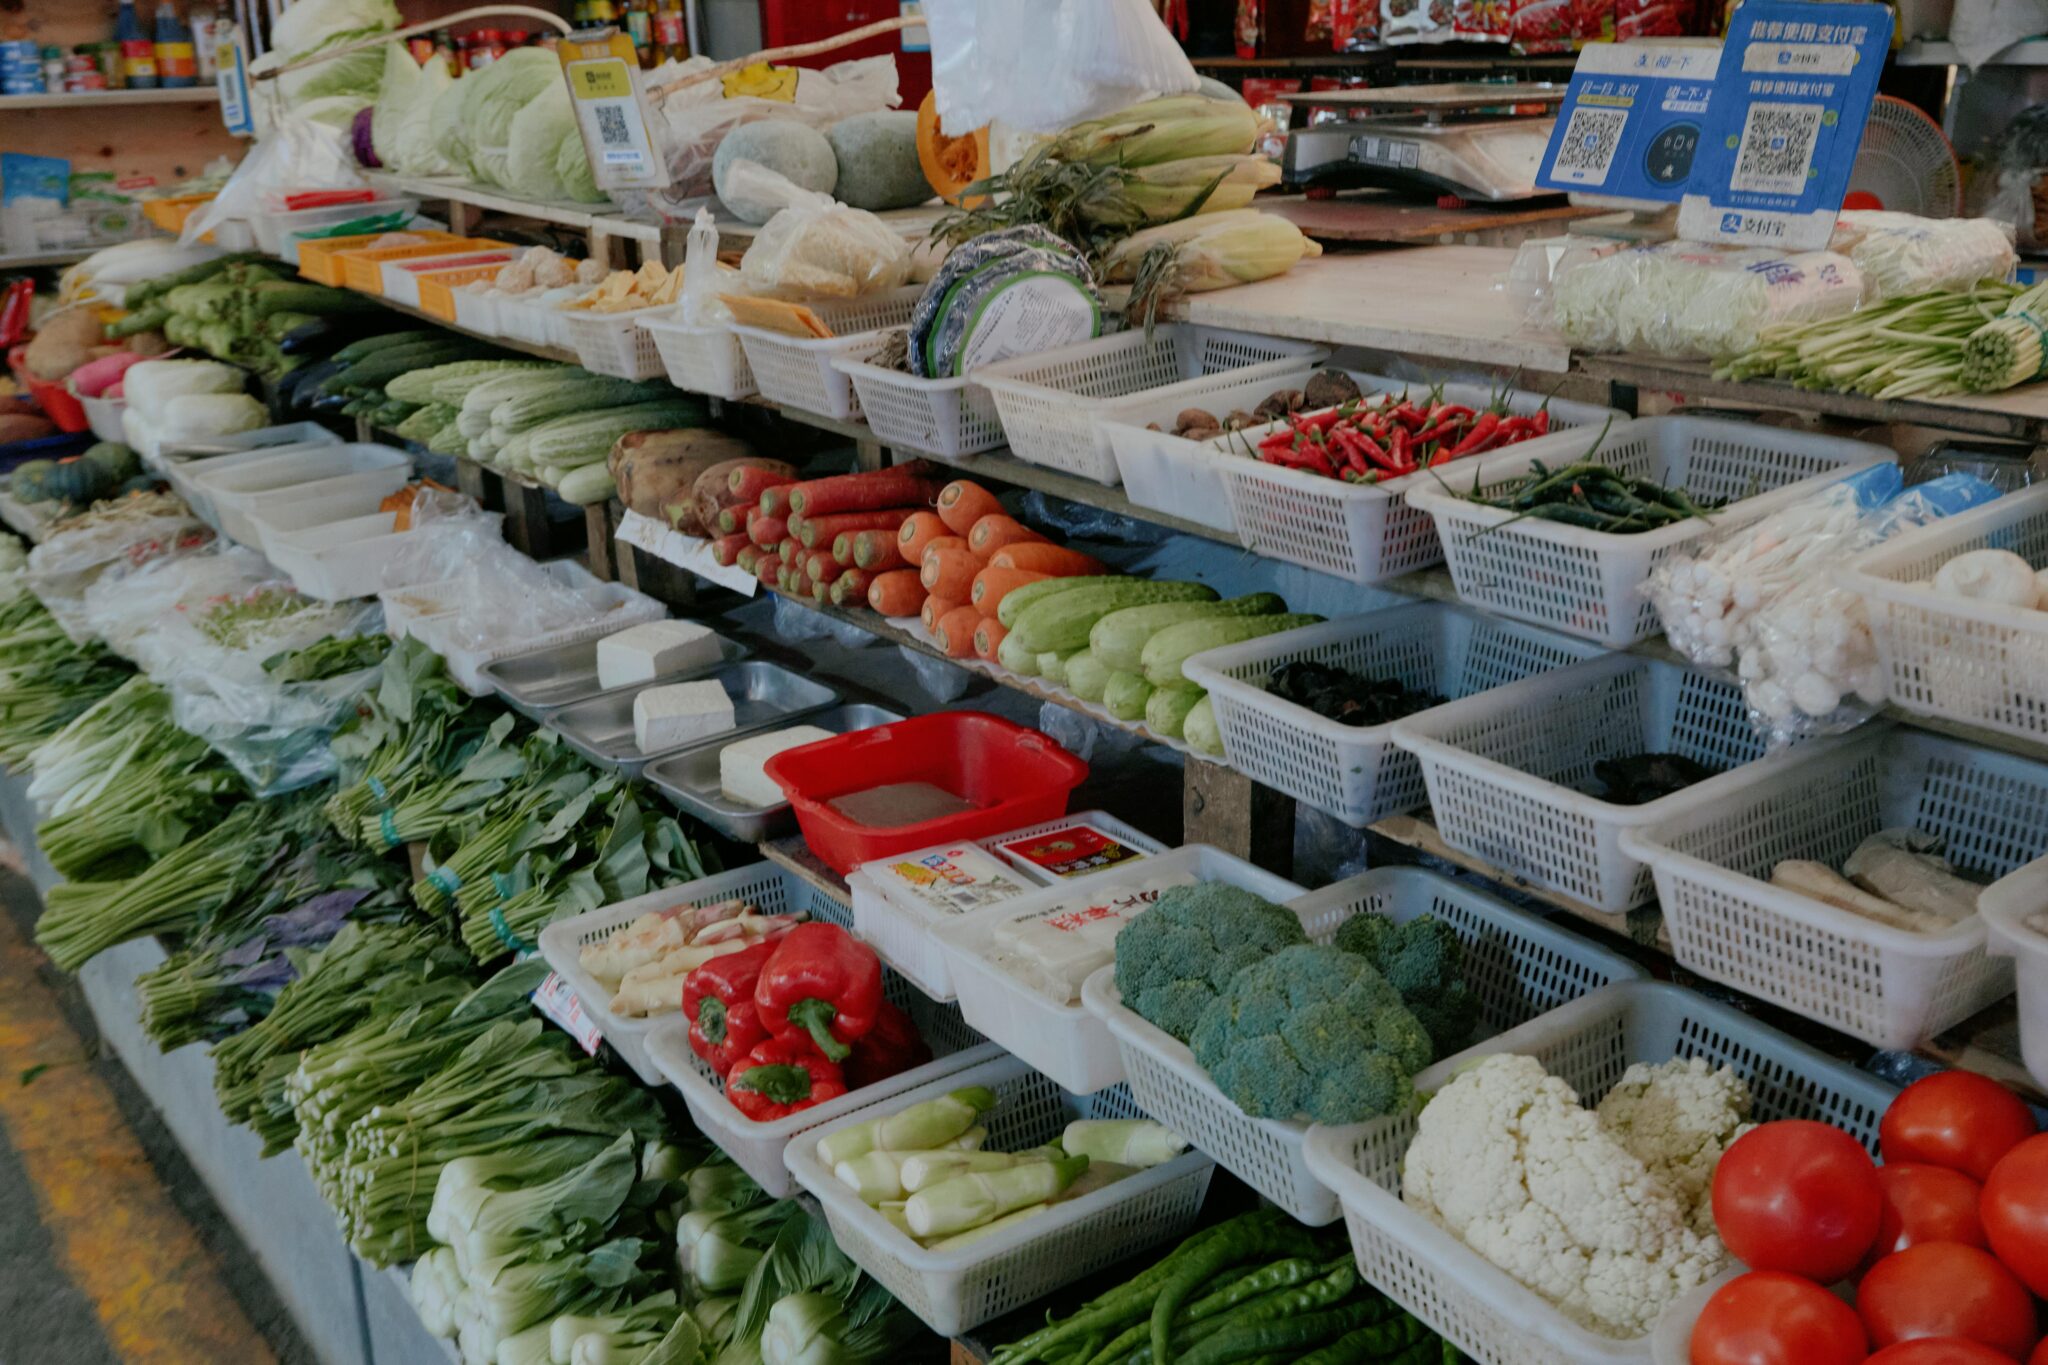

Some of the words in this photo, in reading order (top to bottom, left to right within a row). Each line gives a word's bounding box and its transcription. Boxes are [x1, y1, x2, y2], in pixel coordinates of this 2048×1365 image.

[1750, 20, 1867, 44] 推荐使用支付宝
[1793, 52, 1820, 64] 支付宝
[1749, 79, 1835, 97] 推荐使用支付宝
[1743, 217, 1786, 237] 支付宝
